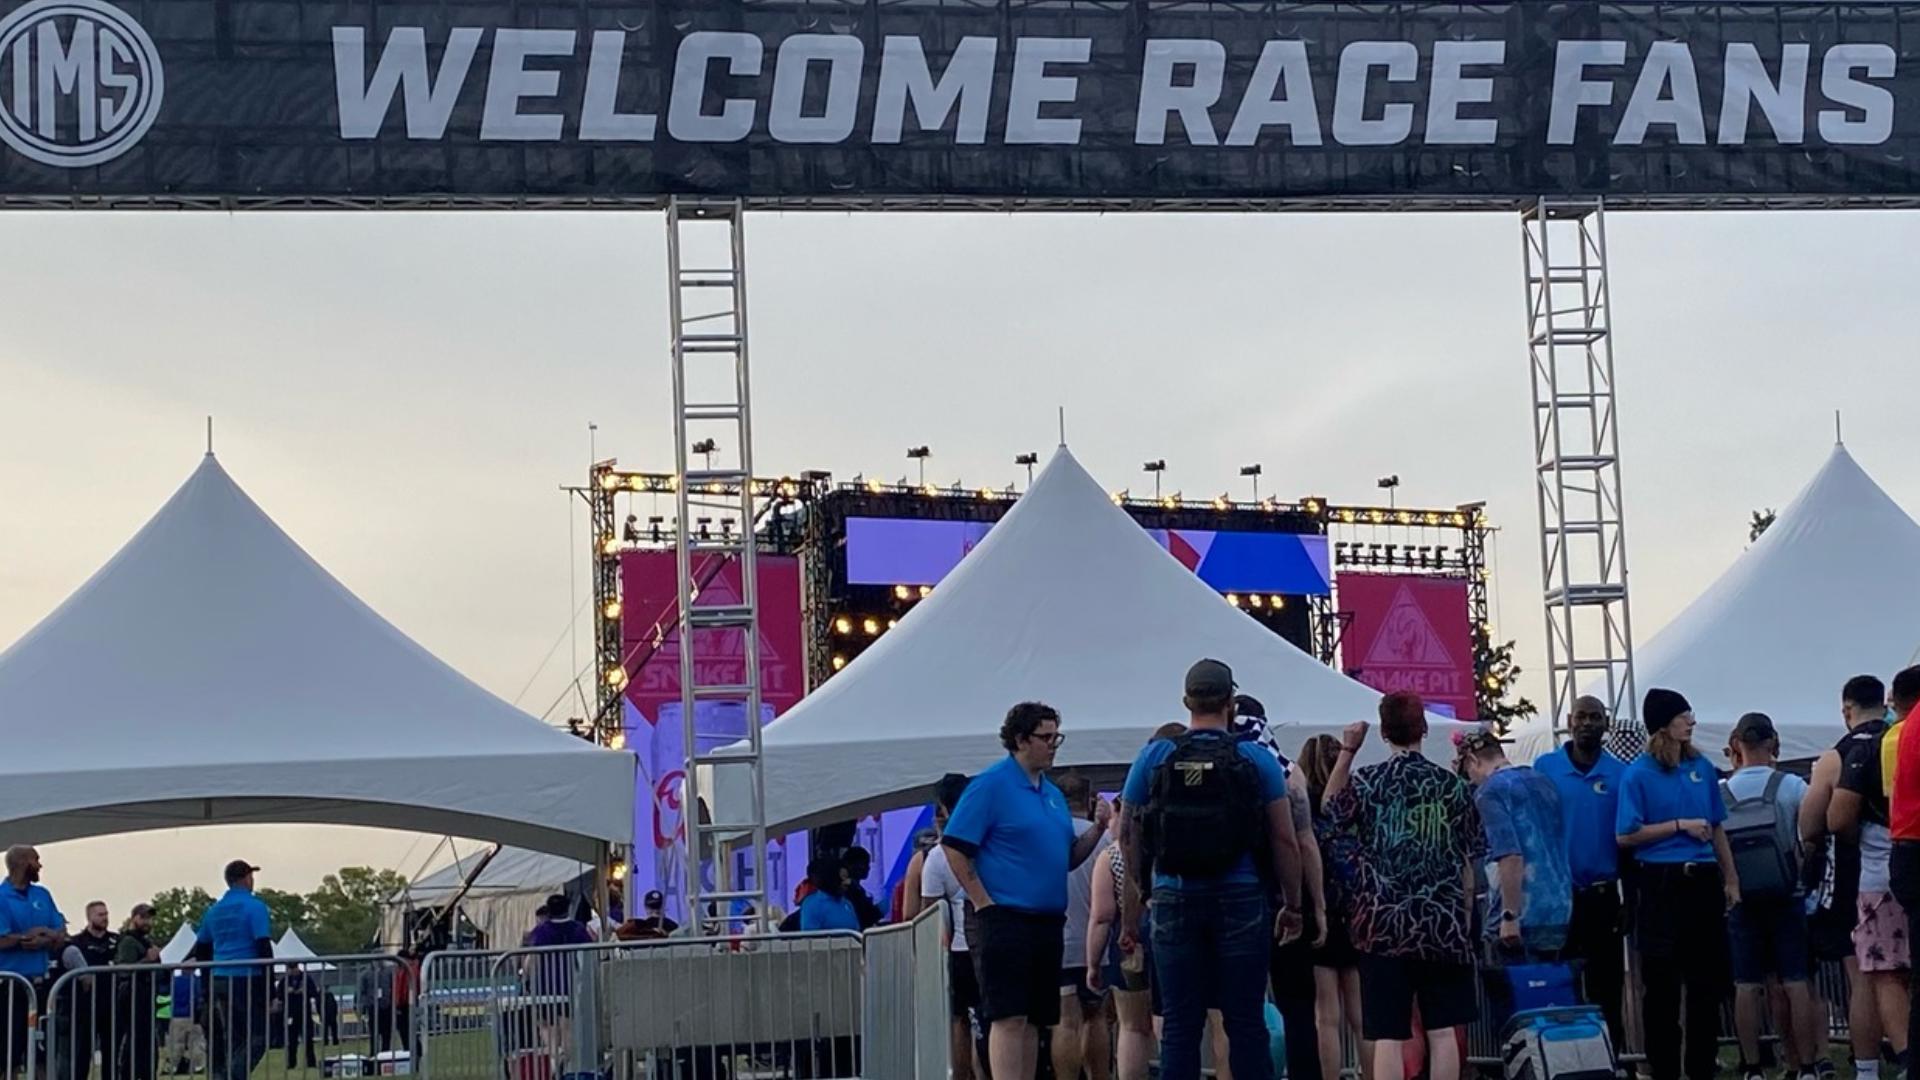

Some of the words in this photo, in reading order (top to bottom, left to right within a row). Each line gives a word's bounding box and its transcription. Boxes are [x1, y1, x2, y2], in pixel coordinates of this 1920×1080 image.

[11, 18, 139, 142] IMS
[331, 25, 1092, 144] WELCOME
[1134, 38, 1506, 146] RACE
[1546, 39, 1896, 146] FANS
[741, 664, 785, 689] IT
[1428, 671, 1461, 693] PIT
